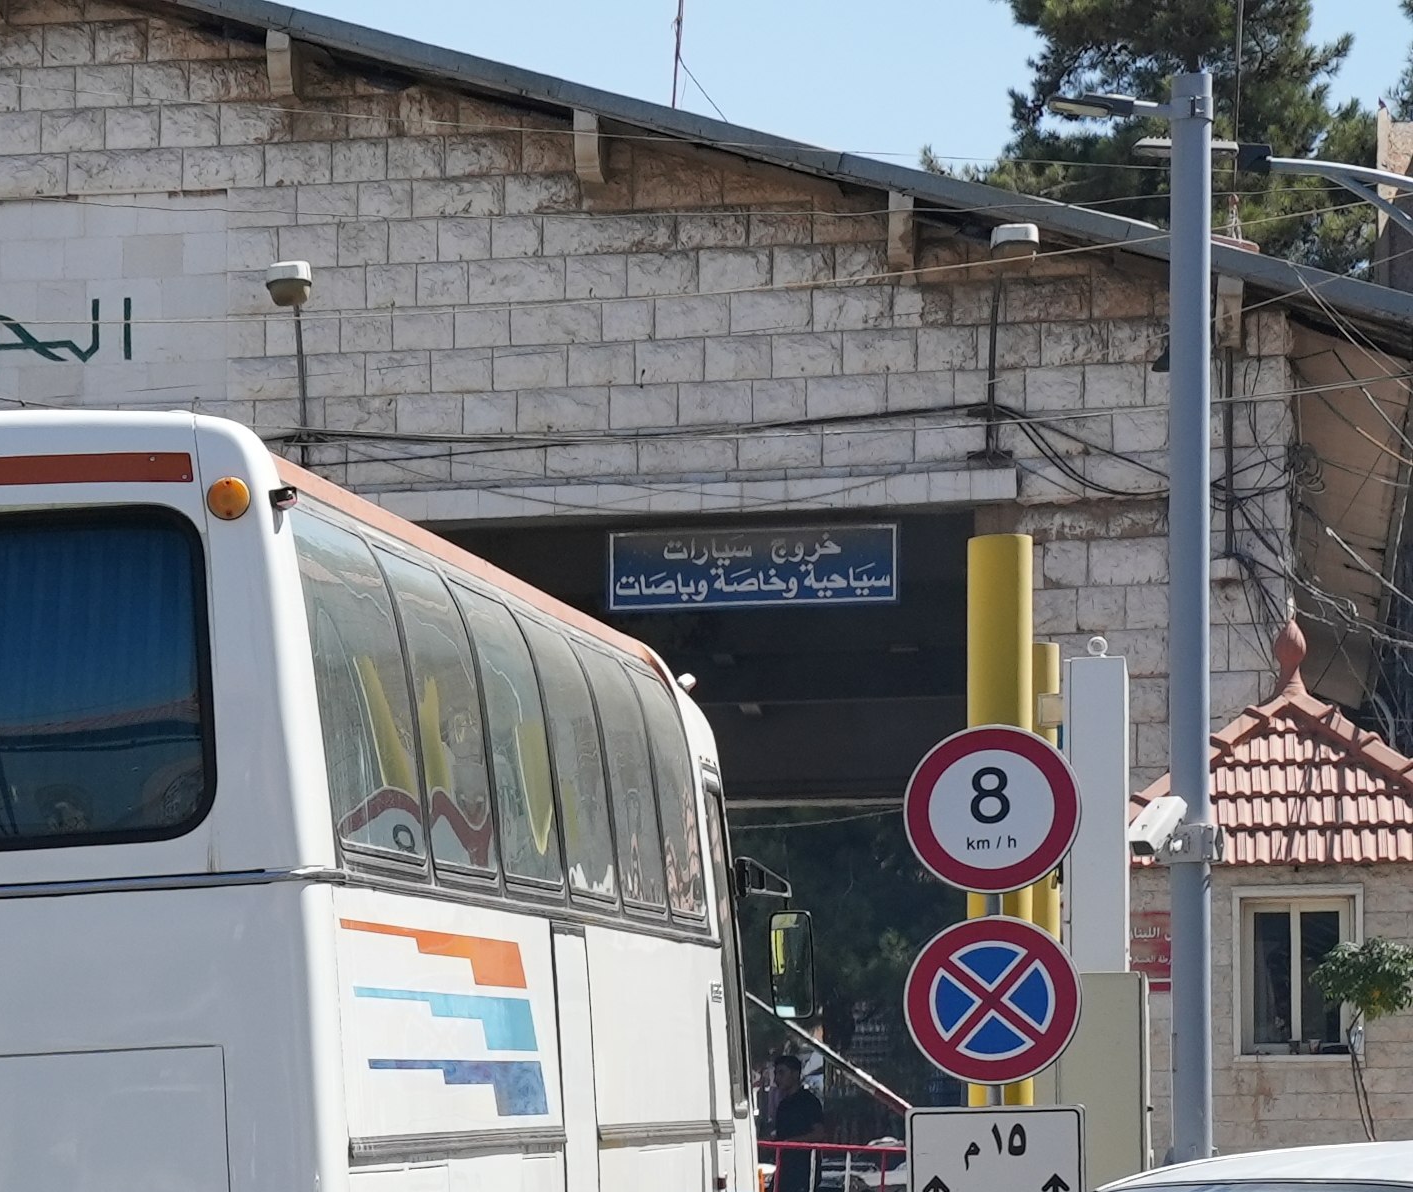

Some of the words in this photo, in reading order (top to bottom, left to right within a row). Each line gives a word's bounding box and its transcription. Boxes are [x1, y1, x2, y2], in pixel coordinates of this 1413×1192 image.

[771, 532, 842, 564] خروج
[970, 766, 1011, 824] 8
[991, 1123, 1027, 1157] ١٥
